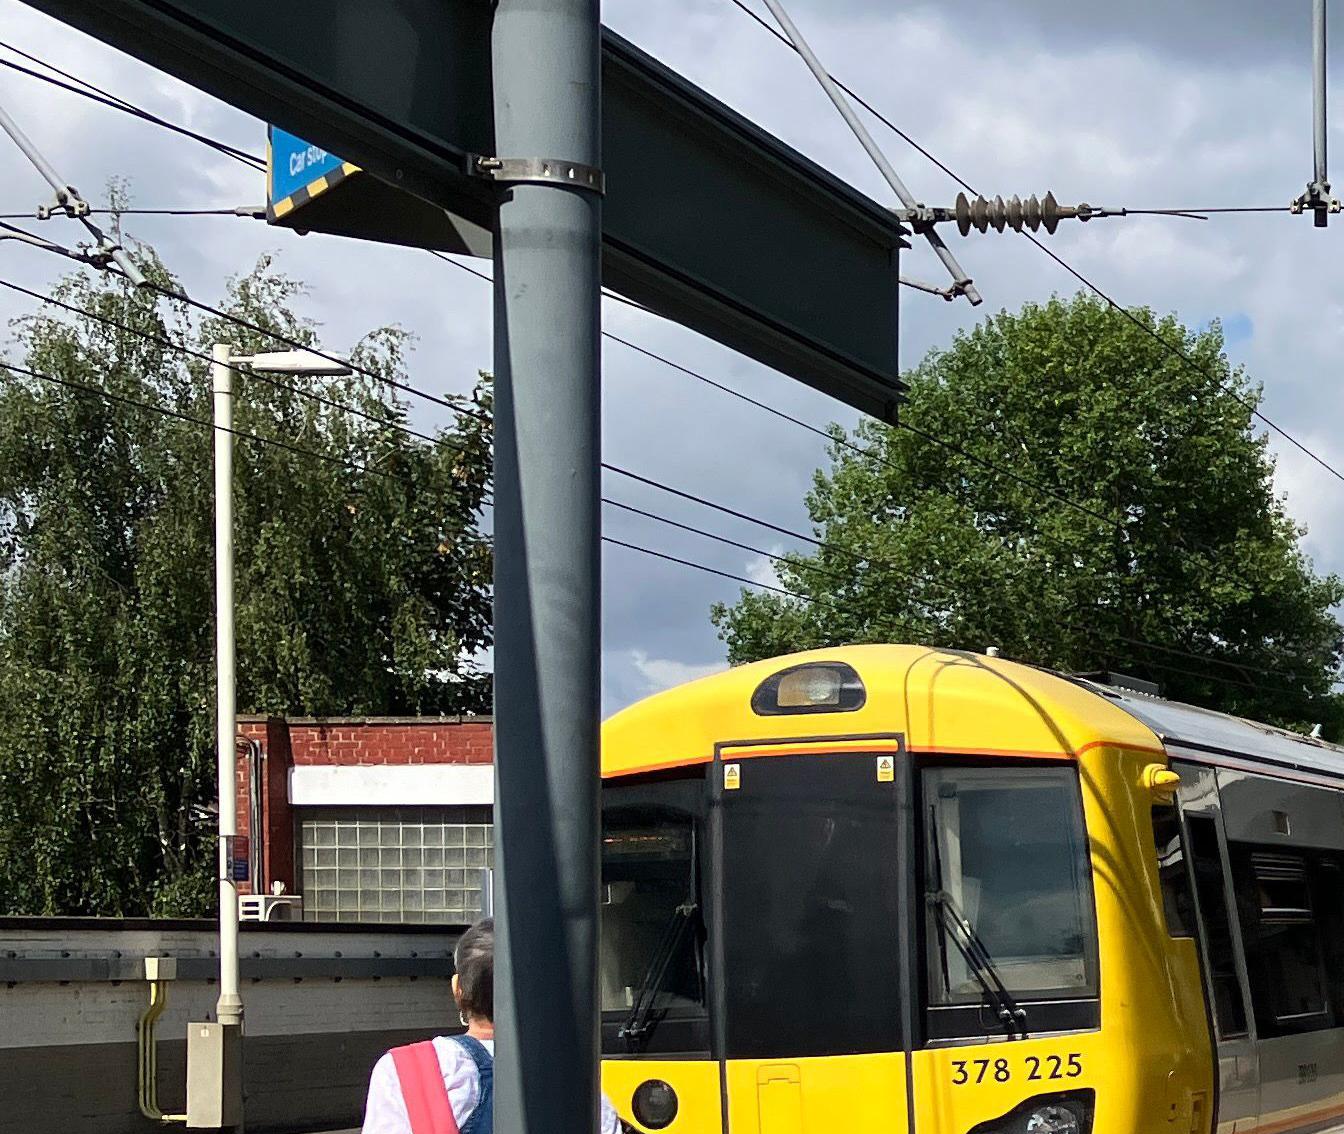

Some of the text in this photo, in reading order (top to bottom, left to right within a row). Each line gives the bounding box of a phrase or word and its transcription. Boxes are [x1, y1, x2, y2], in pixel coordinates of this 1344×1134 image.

[290, 151, 306, 176] Car
[951, 1053, 1082, 1085] 378 225
